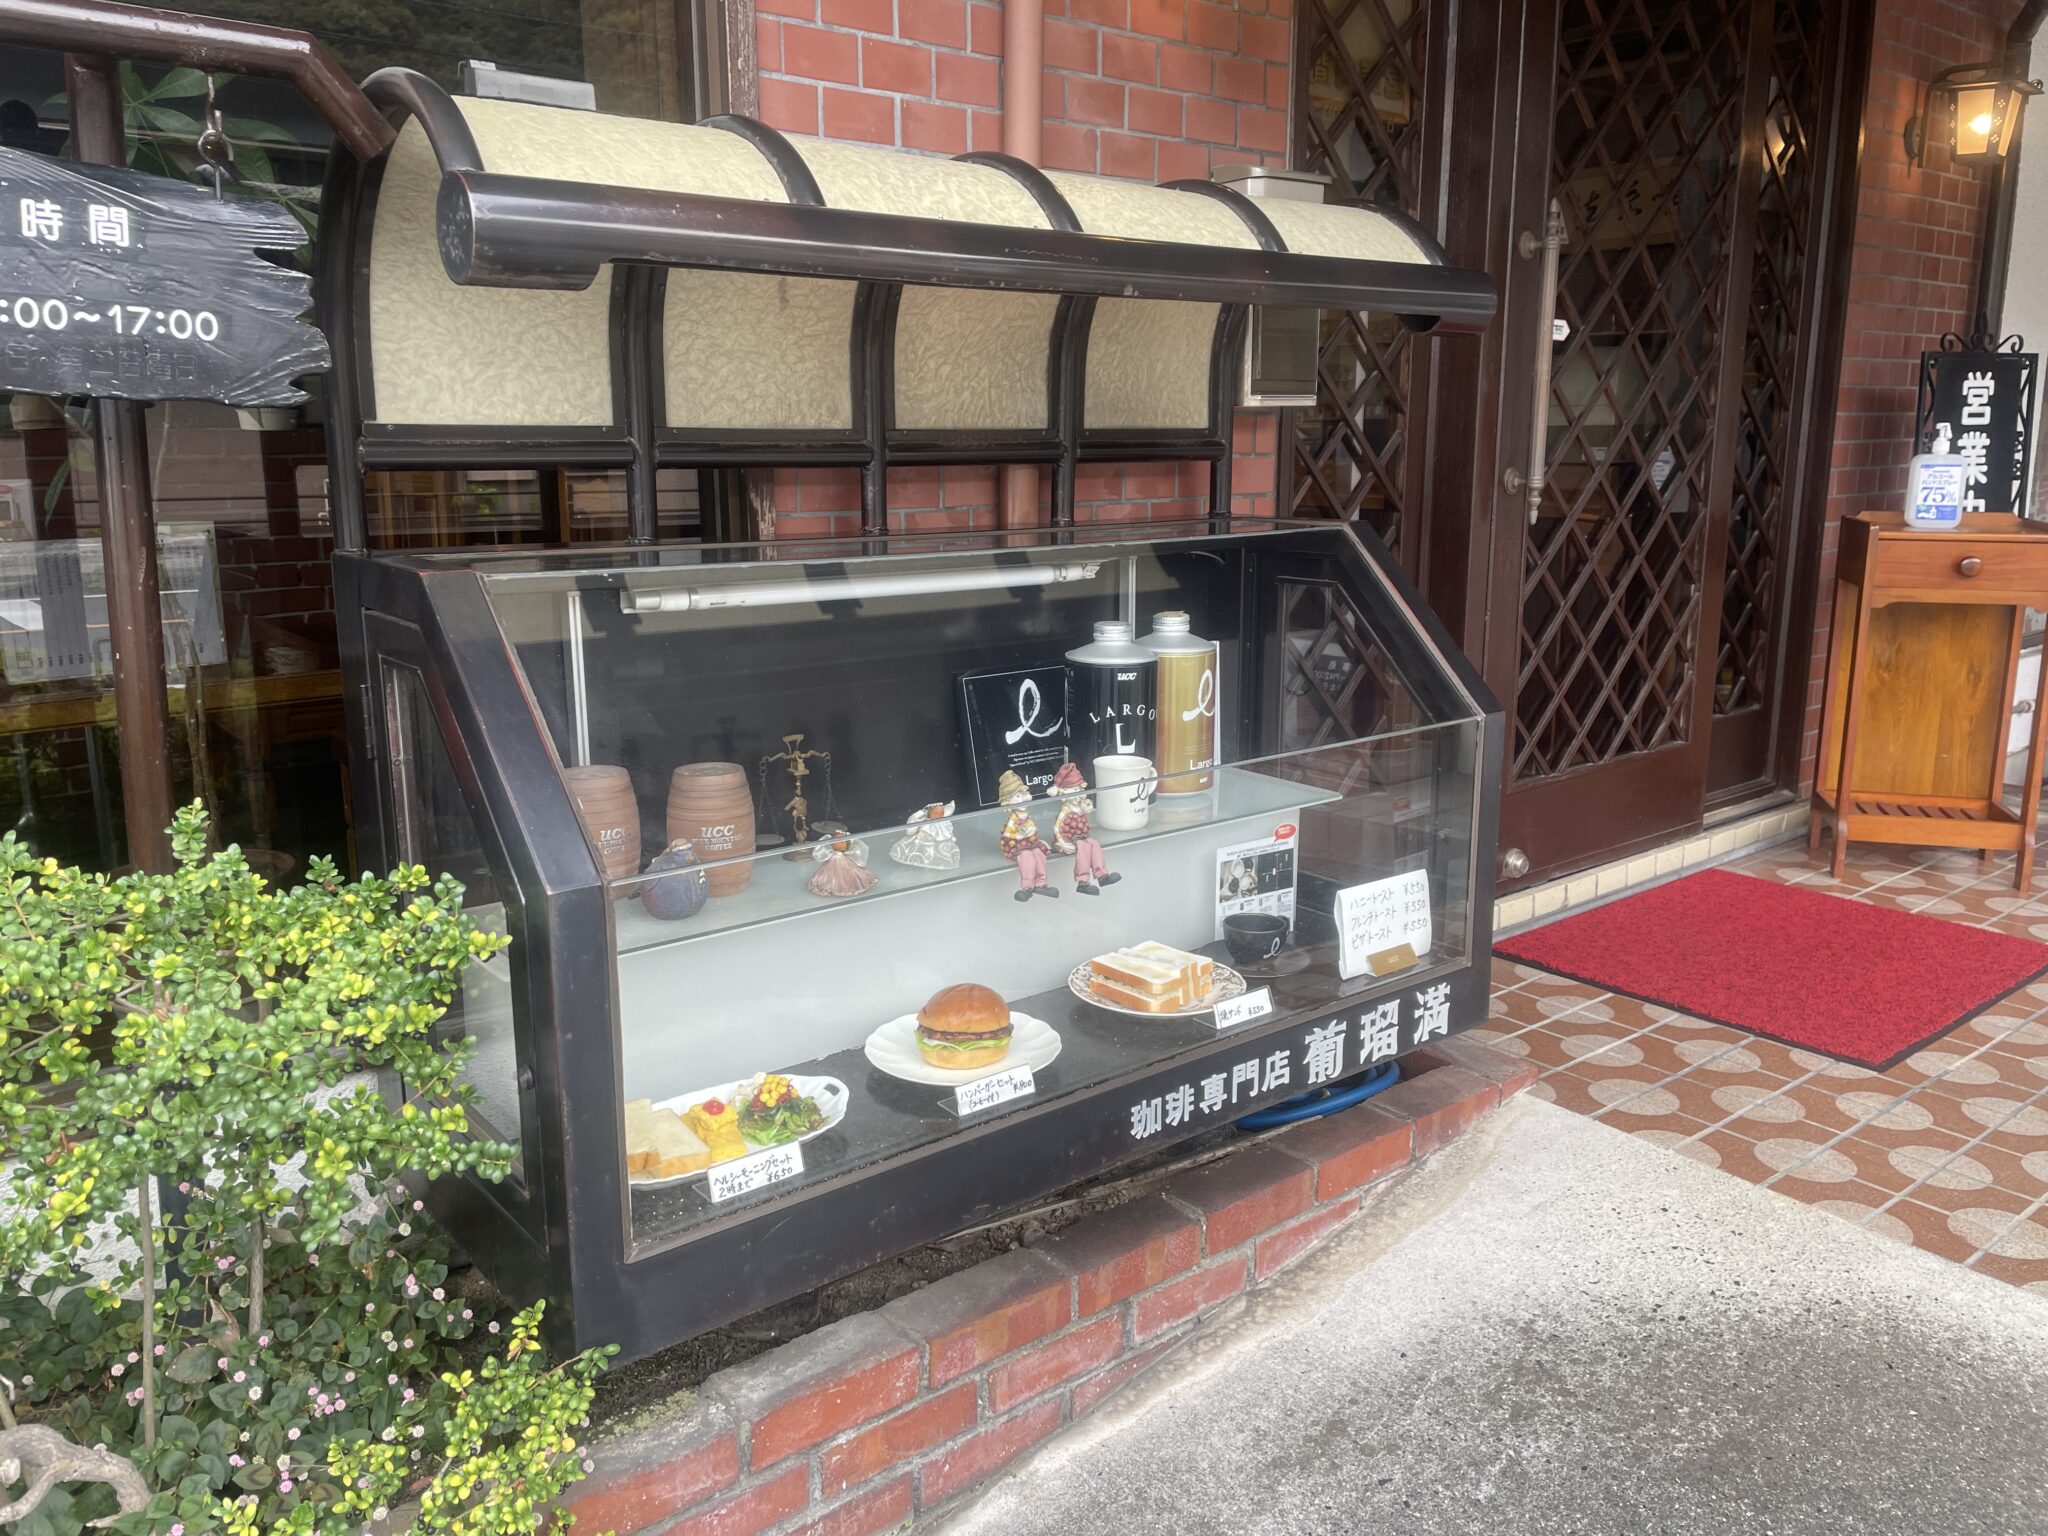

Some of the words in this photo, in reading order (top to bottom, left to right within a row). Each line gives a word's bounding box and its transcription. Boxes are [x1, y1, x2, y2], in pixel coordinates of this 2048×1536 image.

[20, 198, 130, 247] 時間
[1089, 703, 1155, 724] LARGO
[1115, 722, 1136, 754] L
[1025, 774, 1054, 786] Largo
[1130, 1050, 1291, 1140] 珈琲専門店
